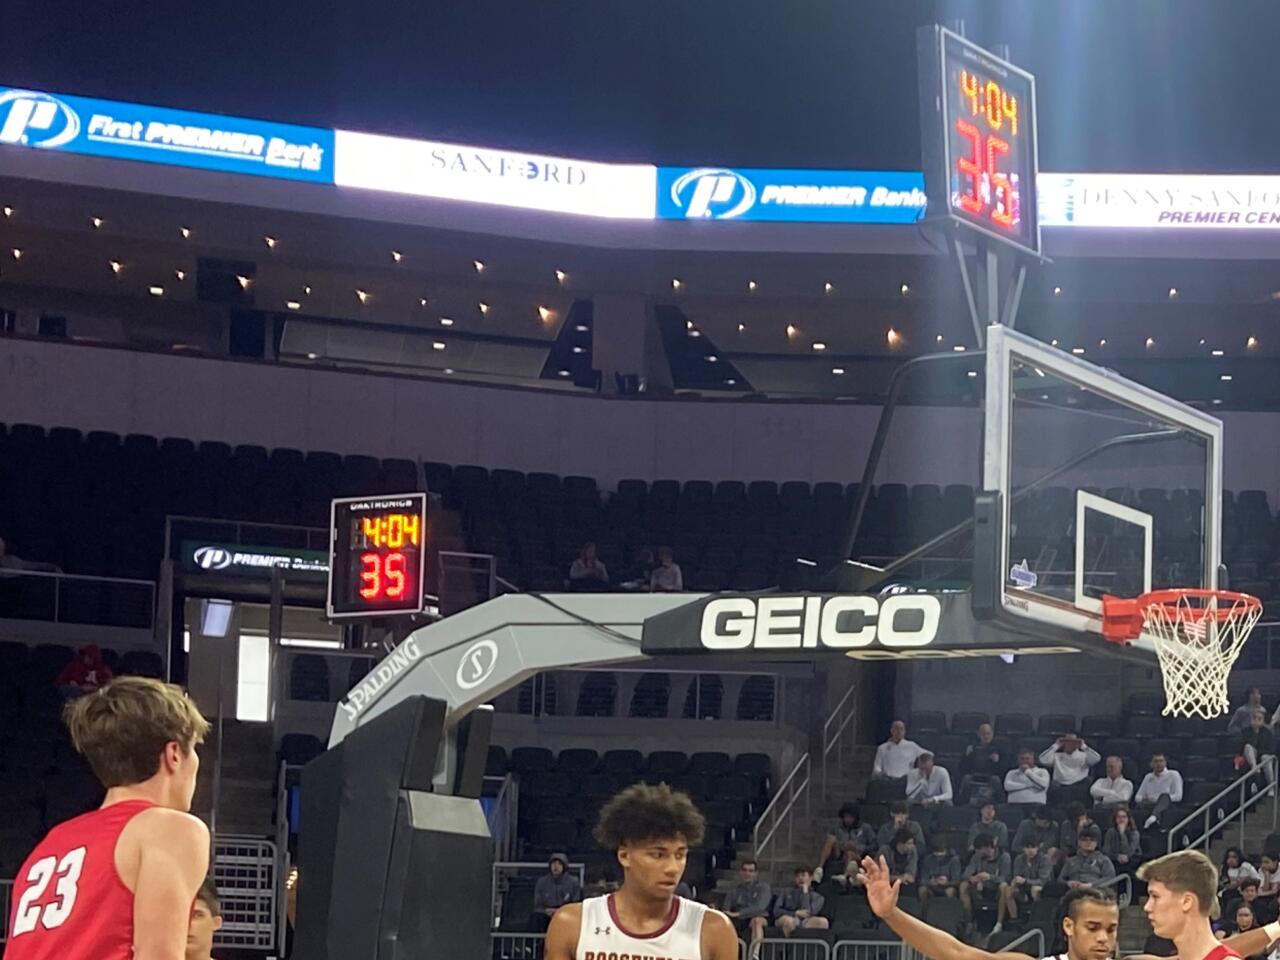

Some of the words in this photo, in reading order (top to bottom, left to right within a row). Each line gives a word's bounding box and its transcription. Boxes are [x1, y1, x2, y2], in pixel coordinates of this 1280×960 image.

[960, 68, 1018, 136] 4:04
[88, 114, 143, 139] First
[144, 121, 265, 156] PREMIER
[265, 136, 325, 170] Bank
[431, 149, 587, 186] SANFORD
[955, 118, 1014, 228] 35
[759, 183, 868, 206] PREMIER
[1157, 210, 1241, 225] PREMIER
[362, 514, 419, 548] 4:04
[233, 553, 291, 569] PREMIER
[360, 553, 406, 598] 35
[700, 594, 942, 650] GEICO
[341, 634, 421, 722] SPALDING
[12, 846, 87, 938] 23
